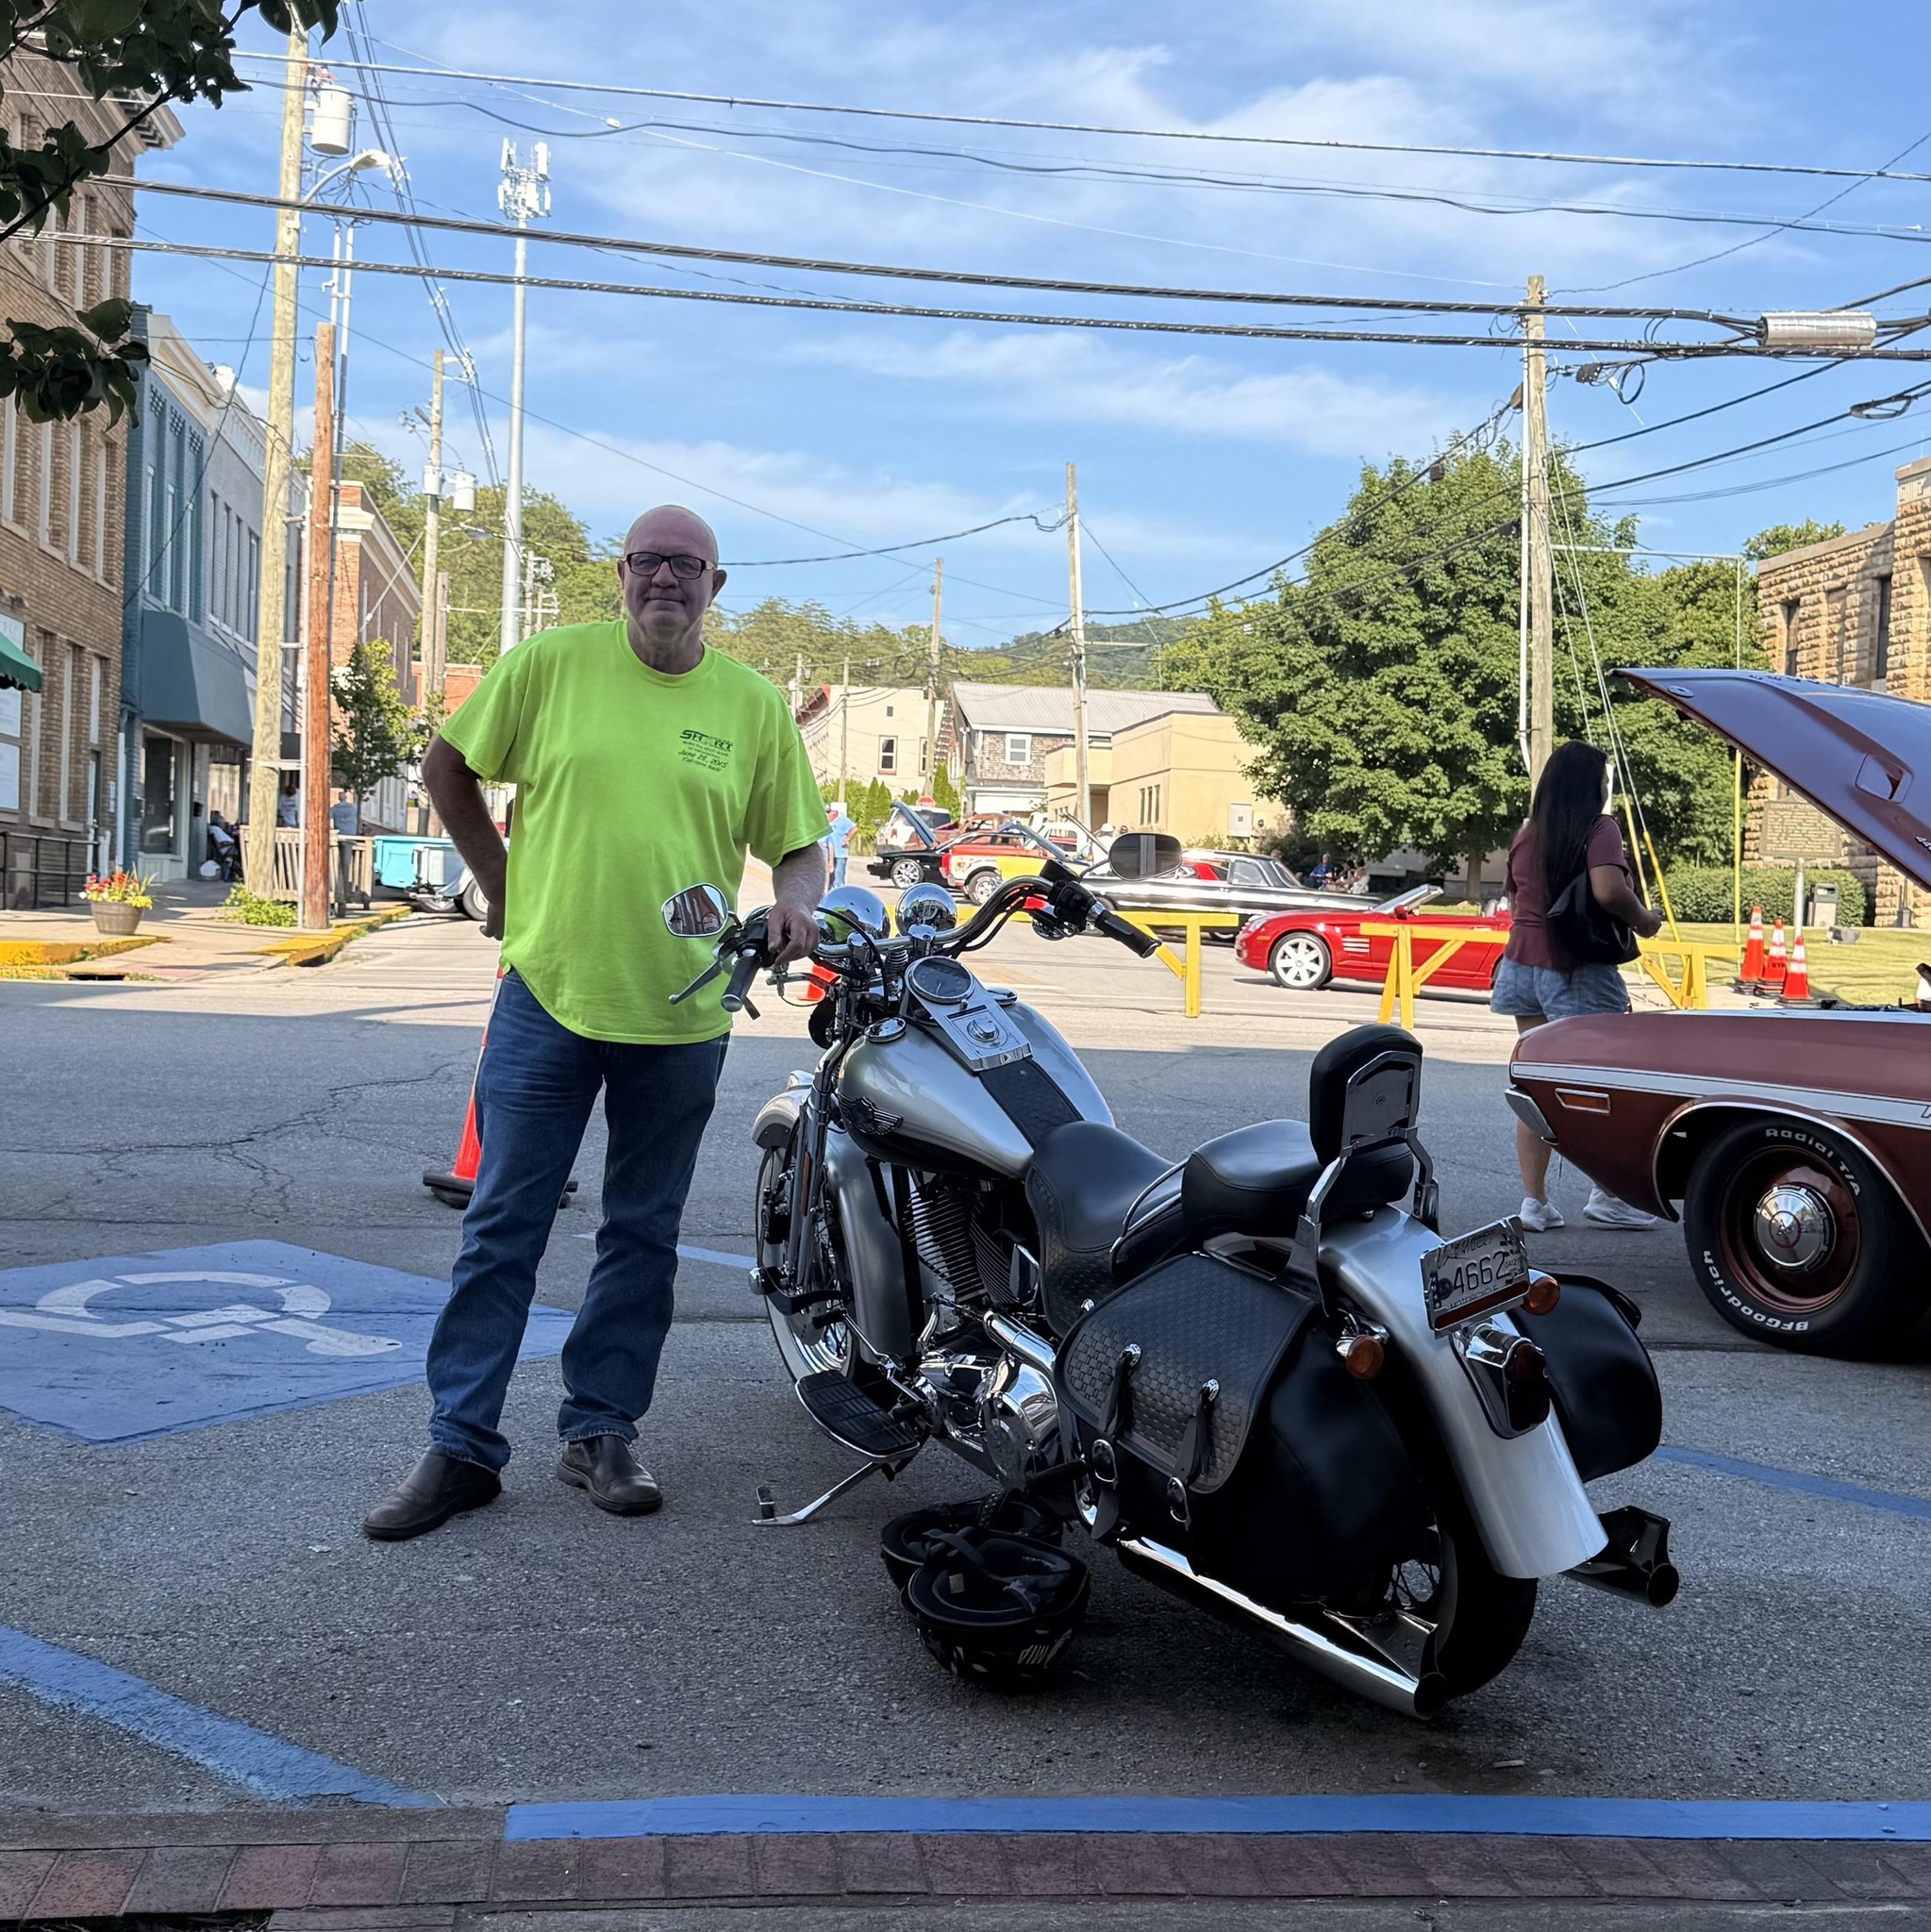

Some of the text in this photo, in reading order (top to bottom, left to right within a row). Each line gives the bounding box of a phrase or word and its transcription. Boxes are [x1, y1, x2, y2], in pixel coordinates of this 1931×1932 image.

[1765, 1128, 1861, 1197] Radial T/A
[1454, 1251, 1509, 1293] 4662
[1703, 1250, 1809, 1331] BFGoodrich
